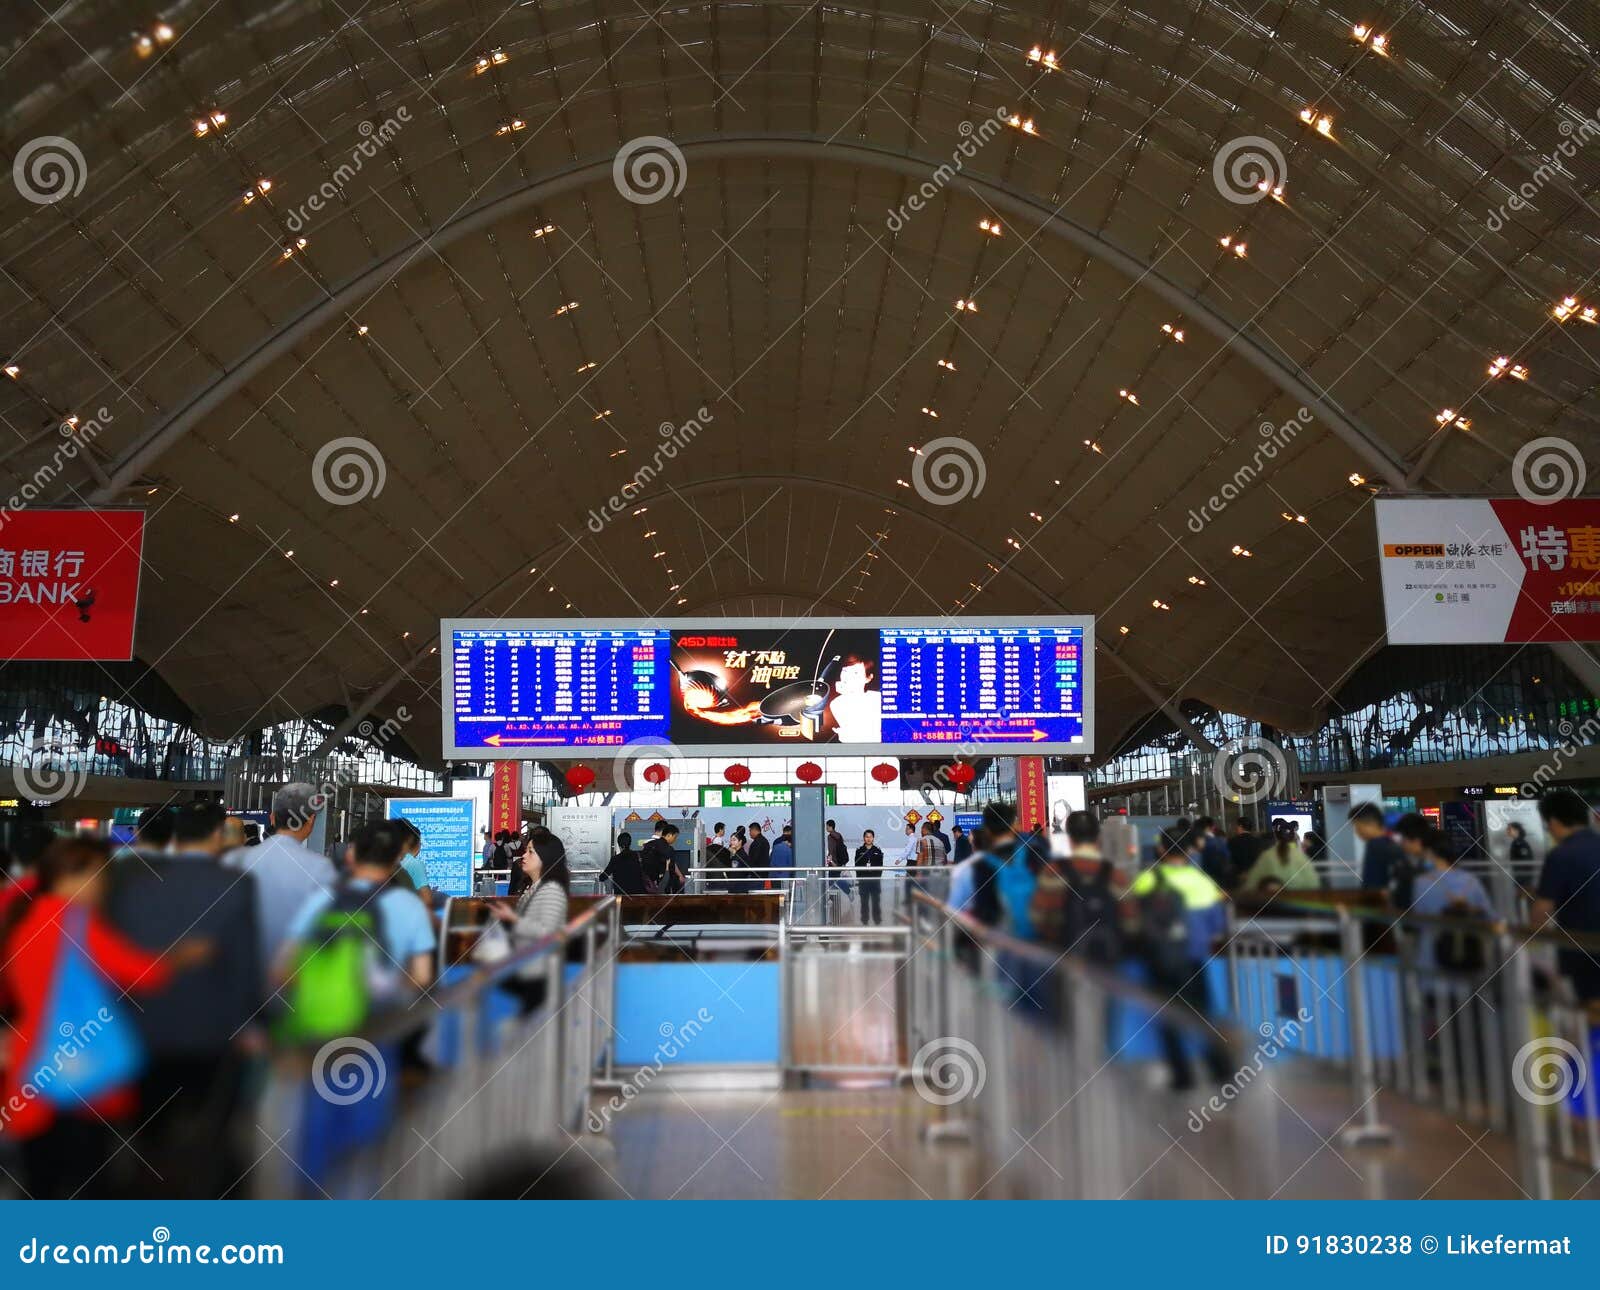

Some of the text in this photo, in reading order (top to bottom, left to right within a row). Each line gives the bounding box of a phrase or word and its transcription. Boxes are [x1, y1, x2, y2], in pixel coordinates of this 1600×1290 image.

[1395, 546, 1443, 555] OPPEIN
[0, 582, 81, 604] BANK
[677, 636, 706, 647] ASD
